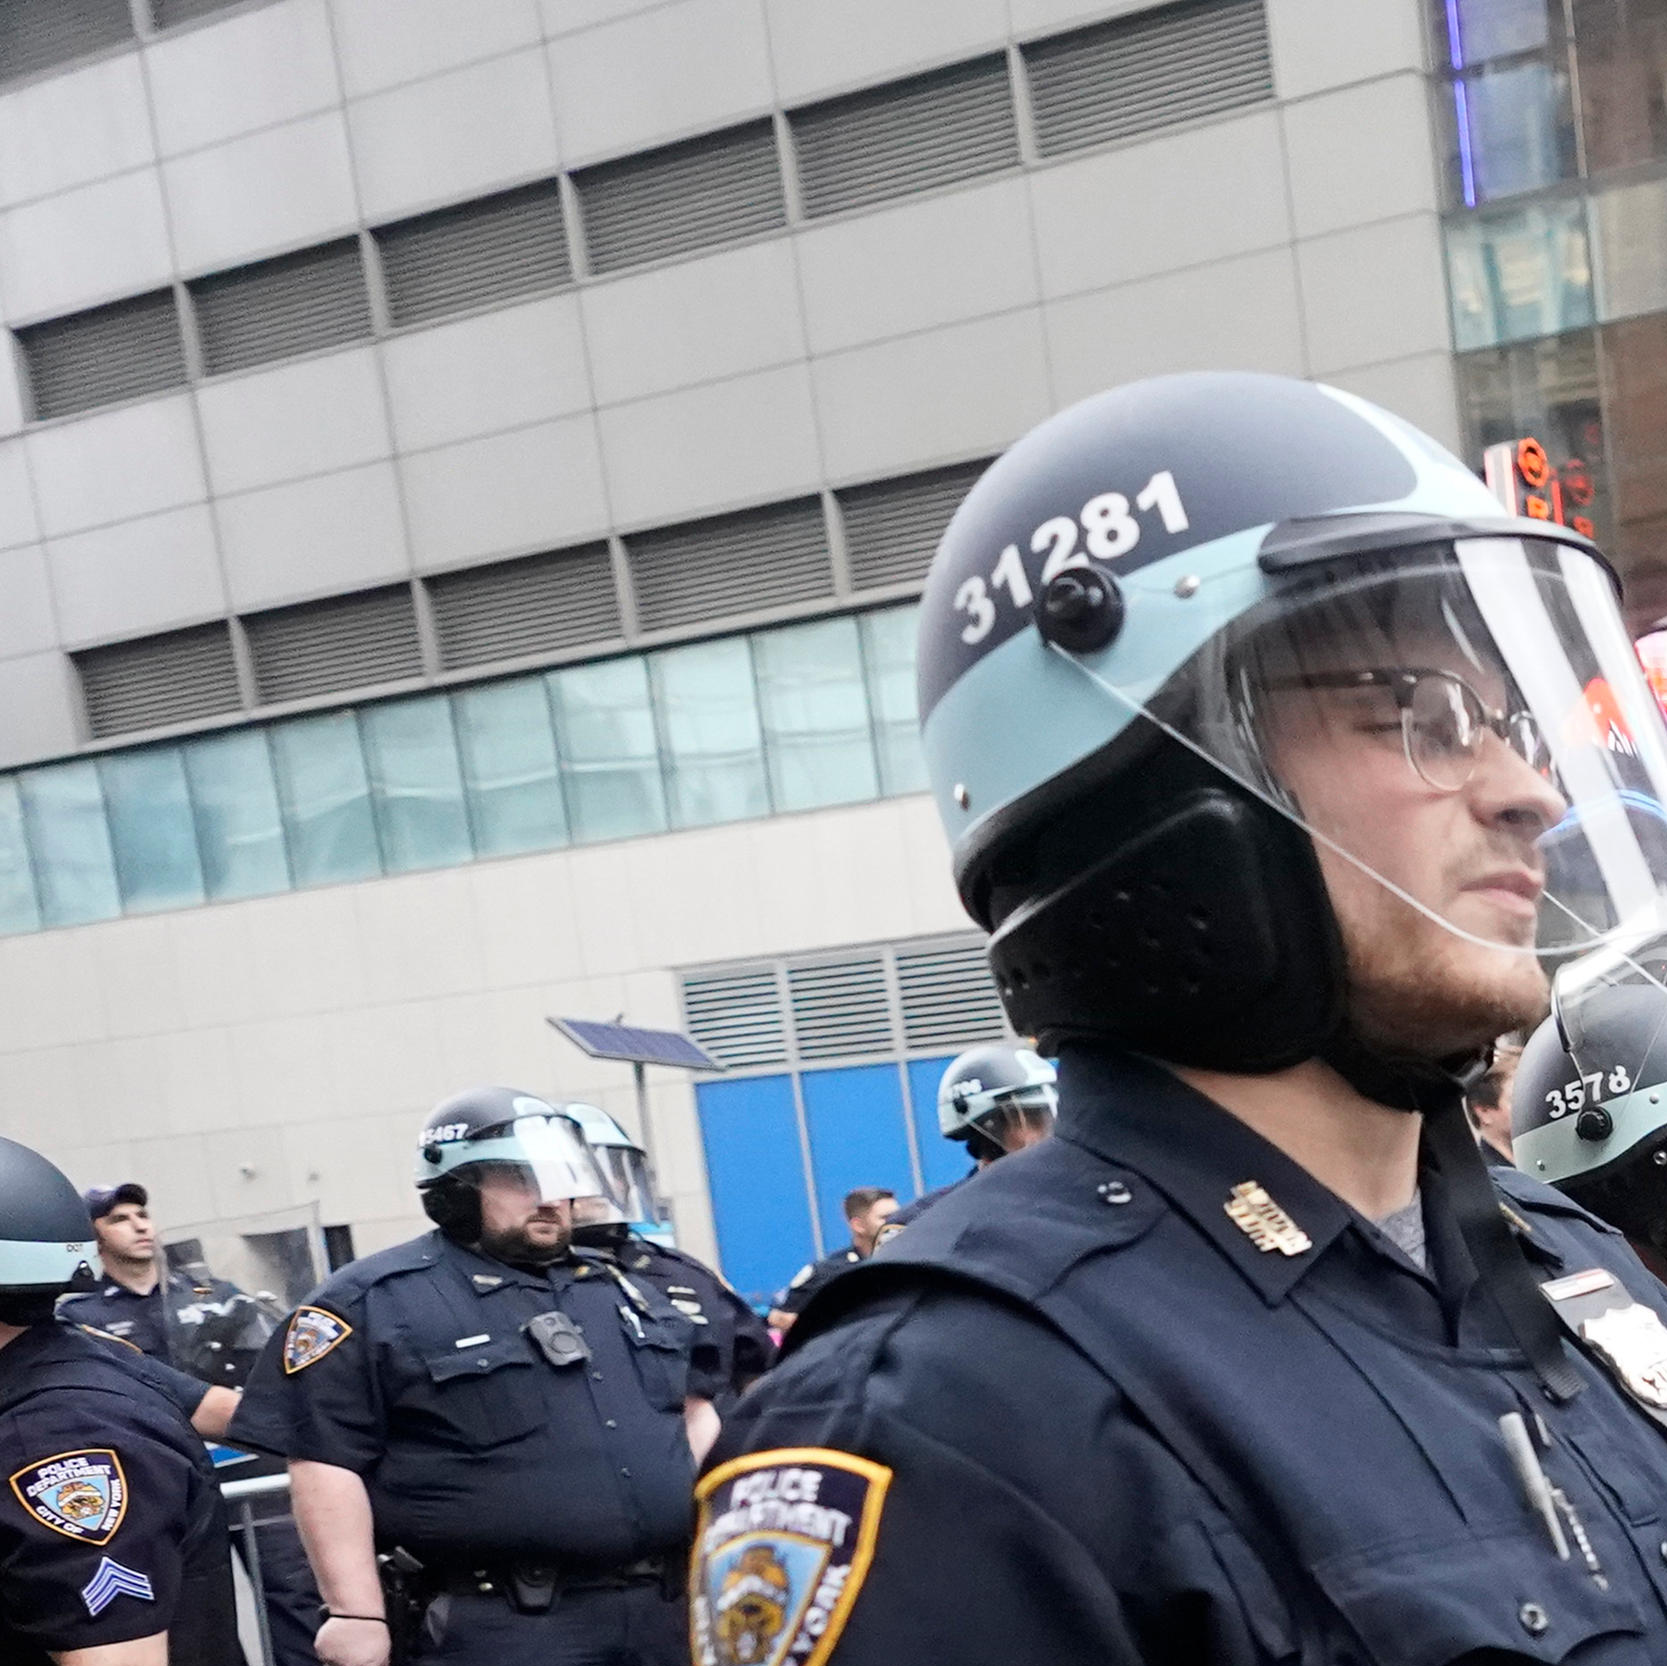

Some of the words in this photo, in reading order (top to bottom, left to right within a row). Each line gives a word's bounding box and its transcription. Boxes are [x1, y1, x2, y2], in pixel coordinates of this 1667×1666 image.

[953, 470, 1191, 645] 31281
[26, 1463, 112, 1497] DEPARTMENT
[37, 1457, 88, 1477] POLICE
[108, 1478, 122, 1508] YORK
[35, 1505, 63, 1528] CITY
[63, 1519, 84, 1535] OF
